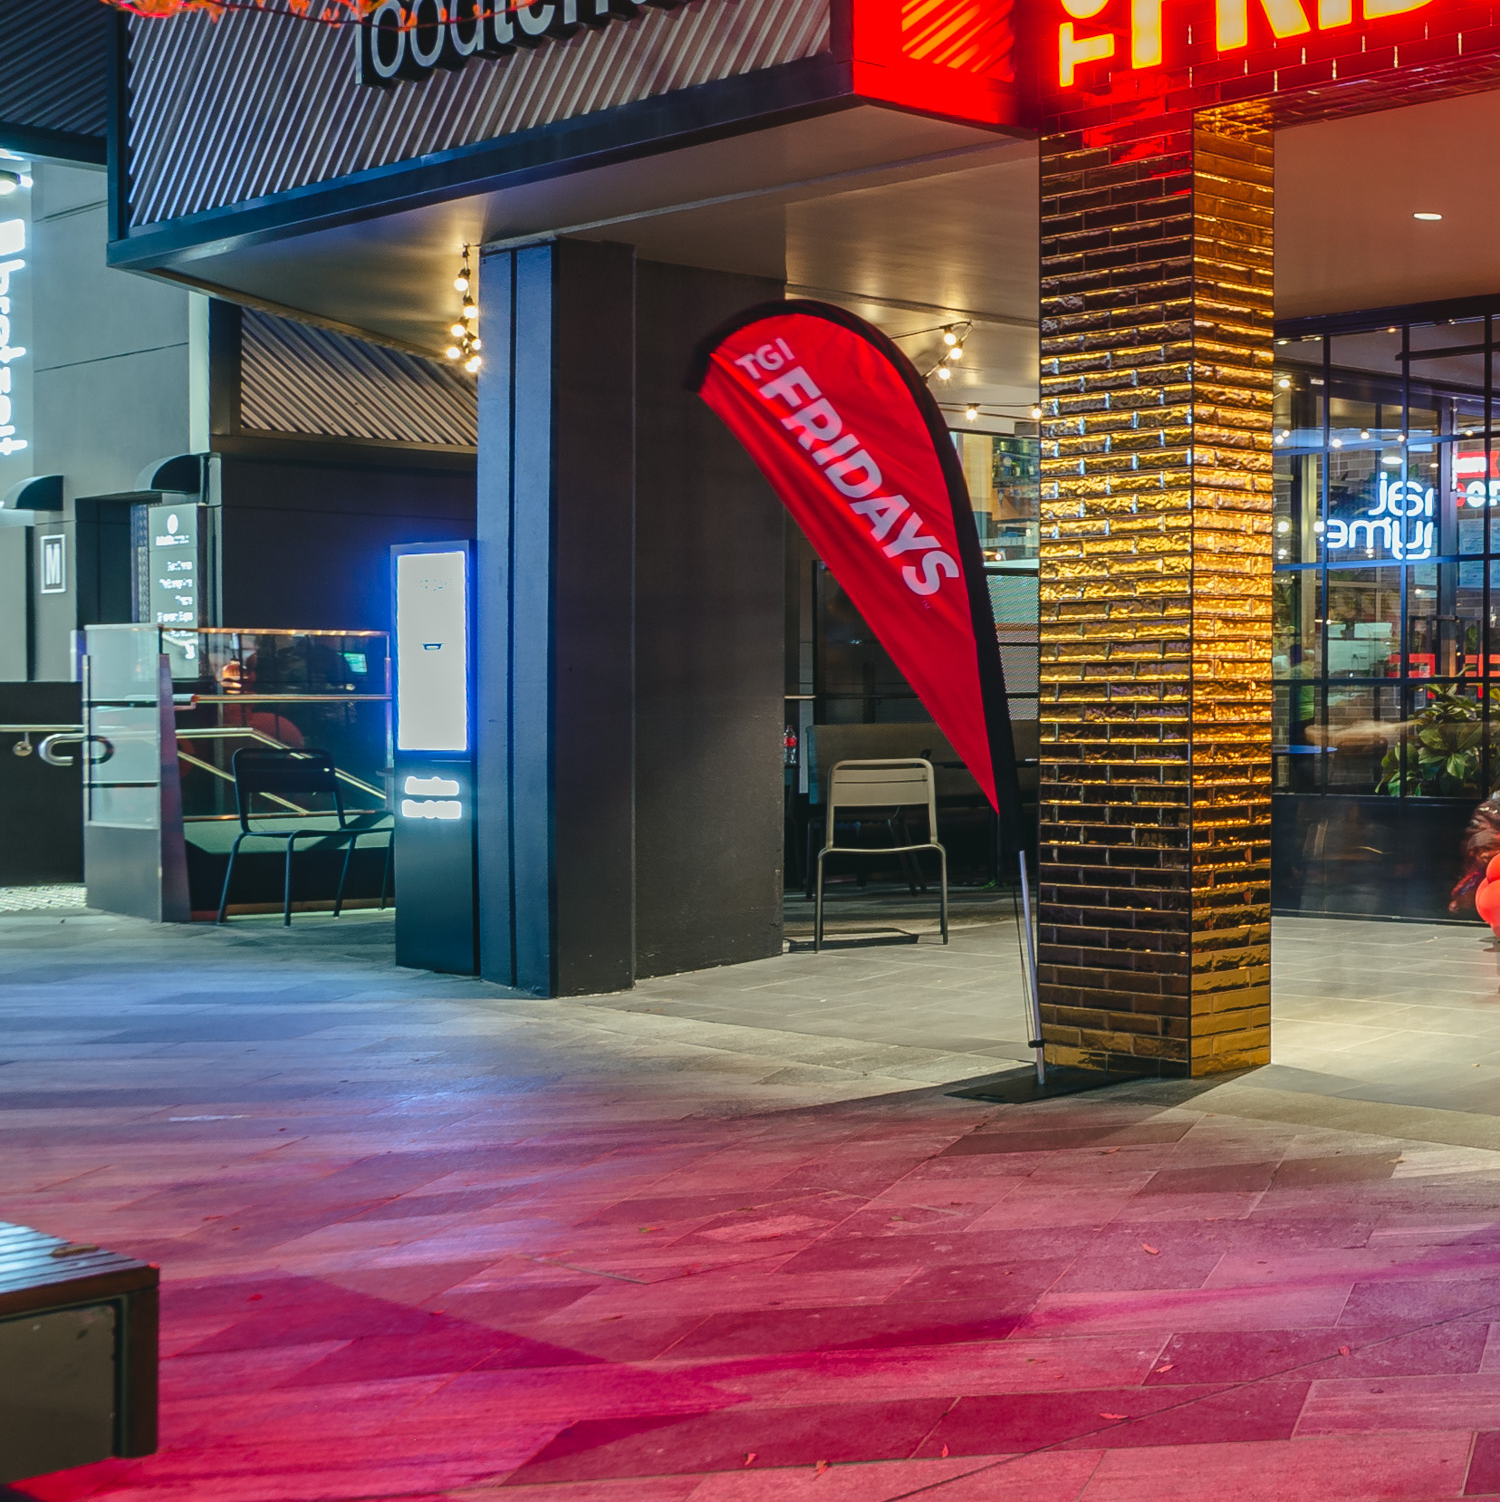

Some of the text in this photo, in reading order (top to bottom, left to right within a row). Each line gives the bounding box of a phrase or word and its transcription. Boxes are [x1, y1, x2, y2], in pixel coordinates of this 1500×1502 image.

[734, 338, 960, 597] TGI FRIDAYS
[46, 543, 61, 585] M
